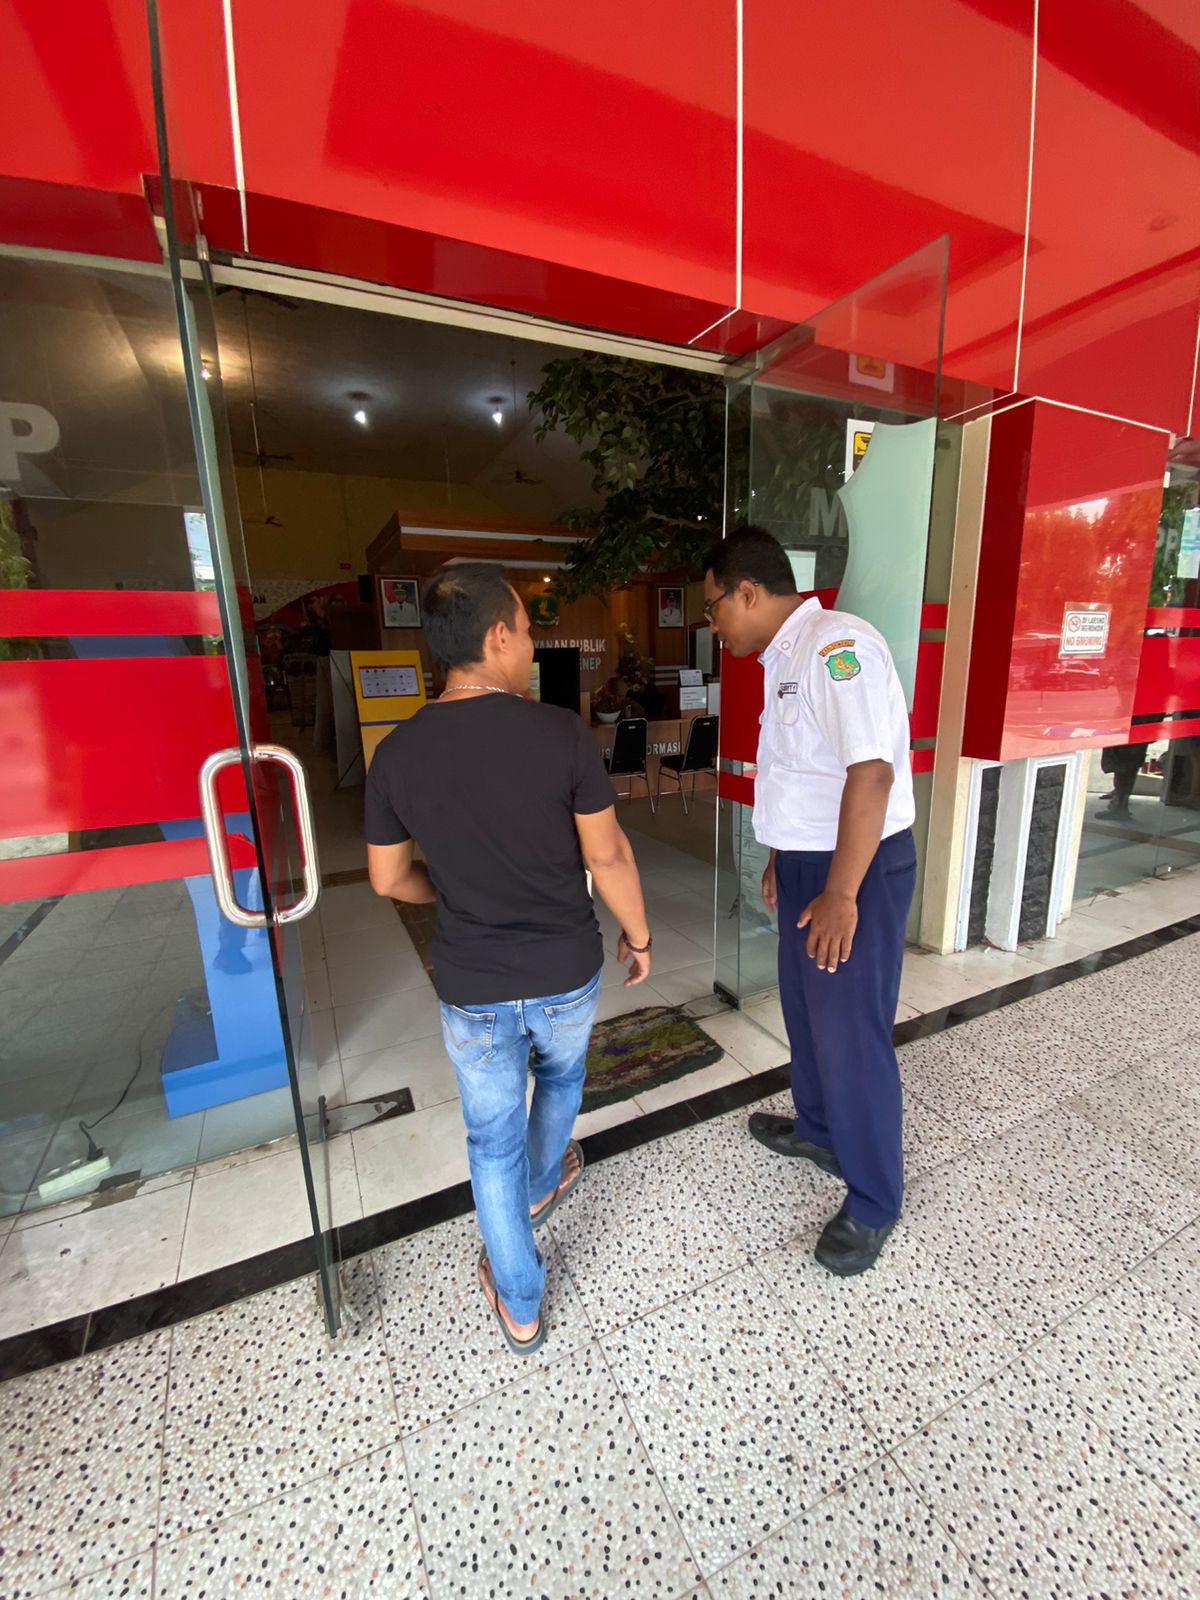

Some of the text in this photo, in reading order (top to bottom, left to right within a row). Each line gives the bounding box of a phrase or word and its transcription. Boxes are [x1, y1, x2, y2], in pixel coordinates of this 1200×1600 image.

[0, 401, 60, 480] P
[534, 639, 568, 649] YANAN
[647, 741, 681, 755] ORMASI
